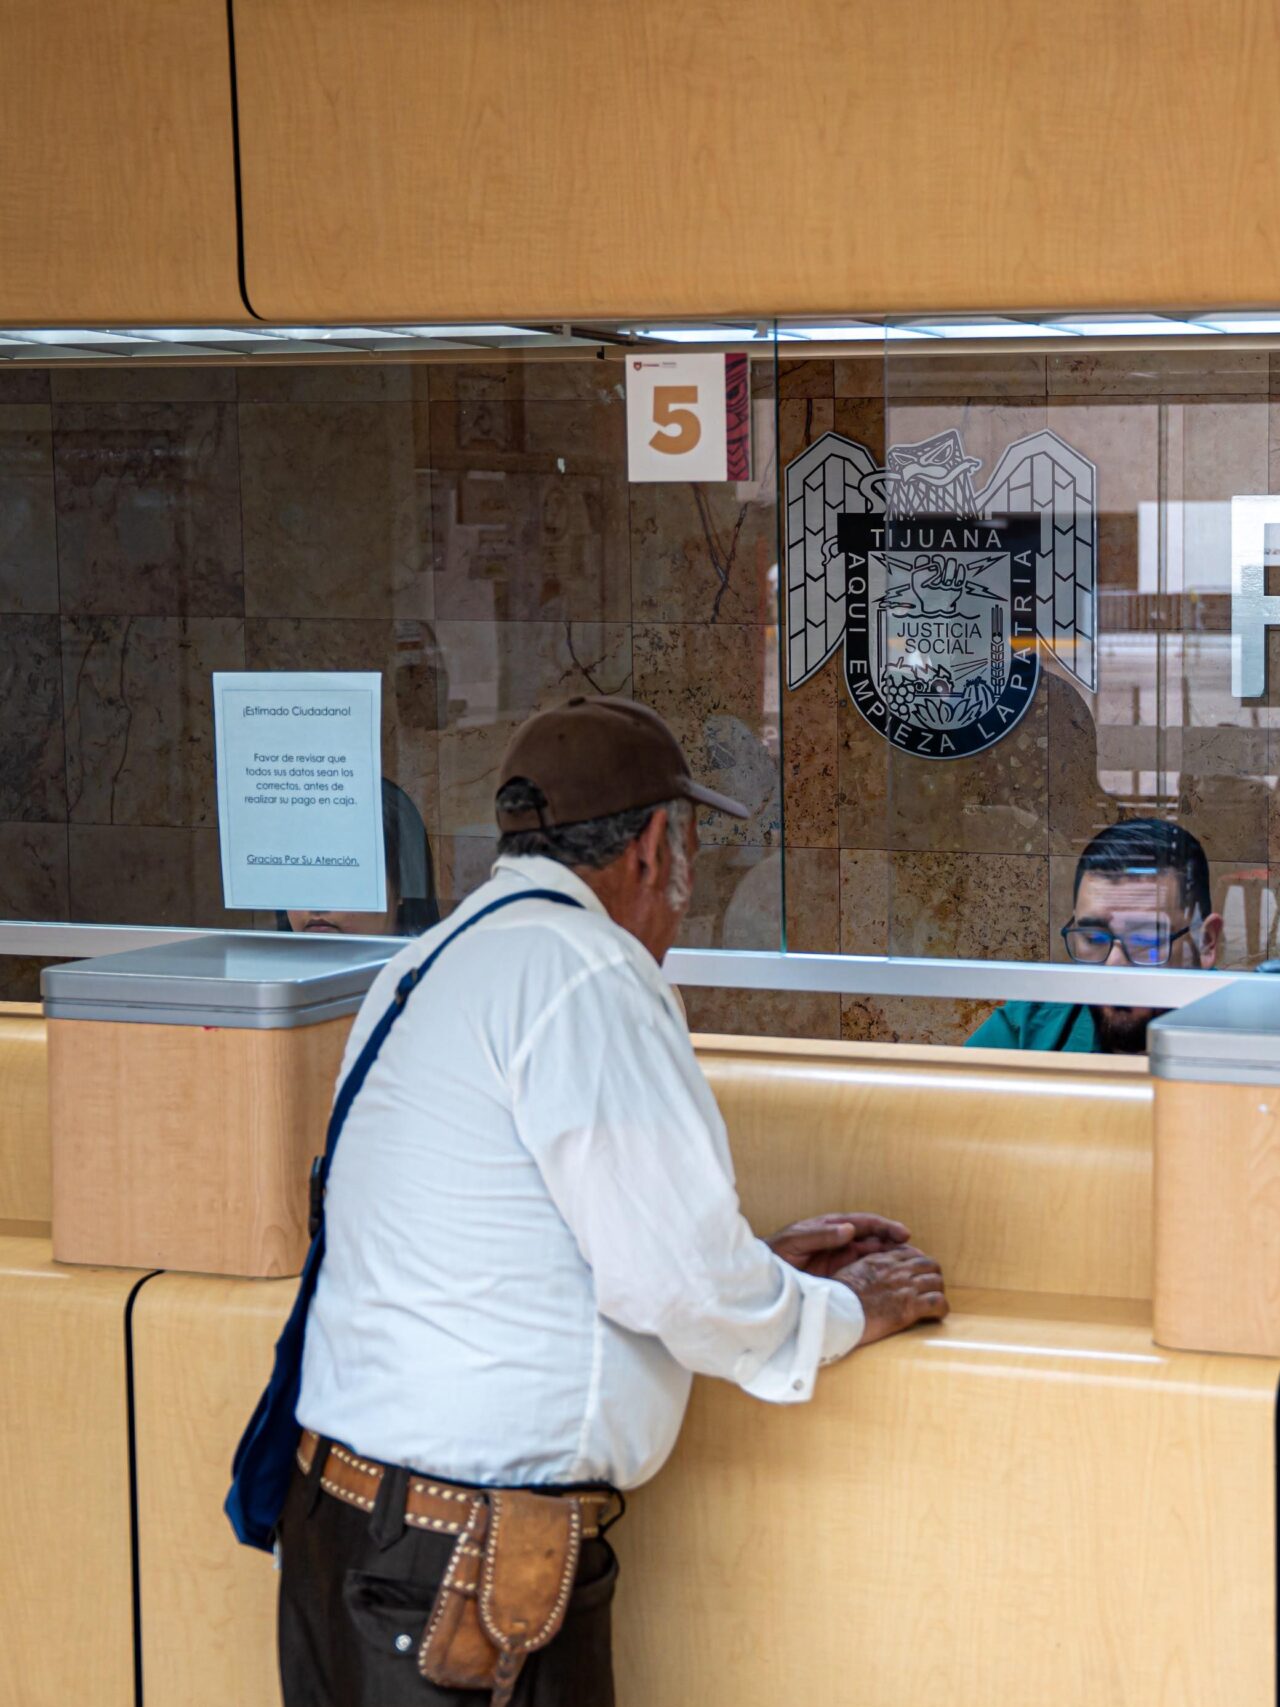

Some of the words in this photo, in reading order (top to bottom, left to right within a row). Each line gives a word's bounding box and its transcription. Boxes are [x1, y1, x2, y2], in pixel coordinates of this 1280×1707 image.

[648, 385, 702, 456] 5
[870, 528, 1002, 549] TIJUANA
[848, 552, 867, 633] AQUI
[1009, 550, 1034, 692] PATRIA
[896, 622, 983, 640] JUSTICIA
[904, 638, 976, 656] SOCIAL
[242, 705, 290, 718] ¡Estimado
[291, 705, 352, 717] Ciudadano!
[850, 659, 956, 754] EMPIEZA
[977, 703, 1016, 740] LA
[253, 752, 280, 763] Favor
[281, 753, 295, 763] de
[296, 753, 325, 763] revisar
[327, 754, 347, 765] que
[245, 766, 272, 777] todos
[273, 768, 287, 777] sus
[288, 767, 315, 778] datos
[316, 768, 339, 778] sean
[340, 767, 354, 778] los
[303, 782, 329, 792] antes
[330, 781, 345, 792] de
[244, 795, 278, 805] realizar
[279, 796, 289, 805] su
[291, 796, 316, 807] pago
[318, 796, 331, 806] en
[332, 795, 357, 807] caja.
[246, 854, 282, 866] Gracias
[284, 854, 300, 866] Por
[301, 855, 313, 866] Su
[314, 855, 360, 867] Atención.
